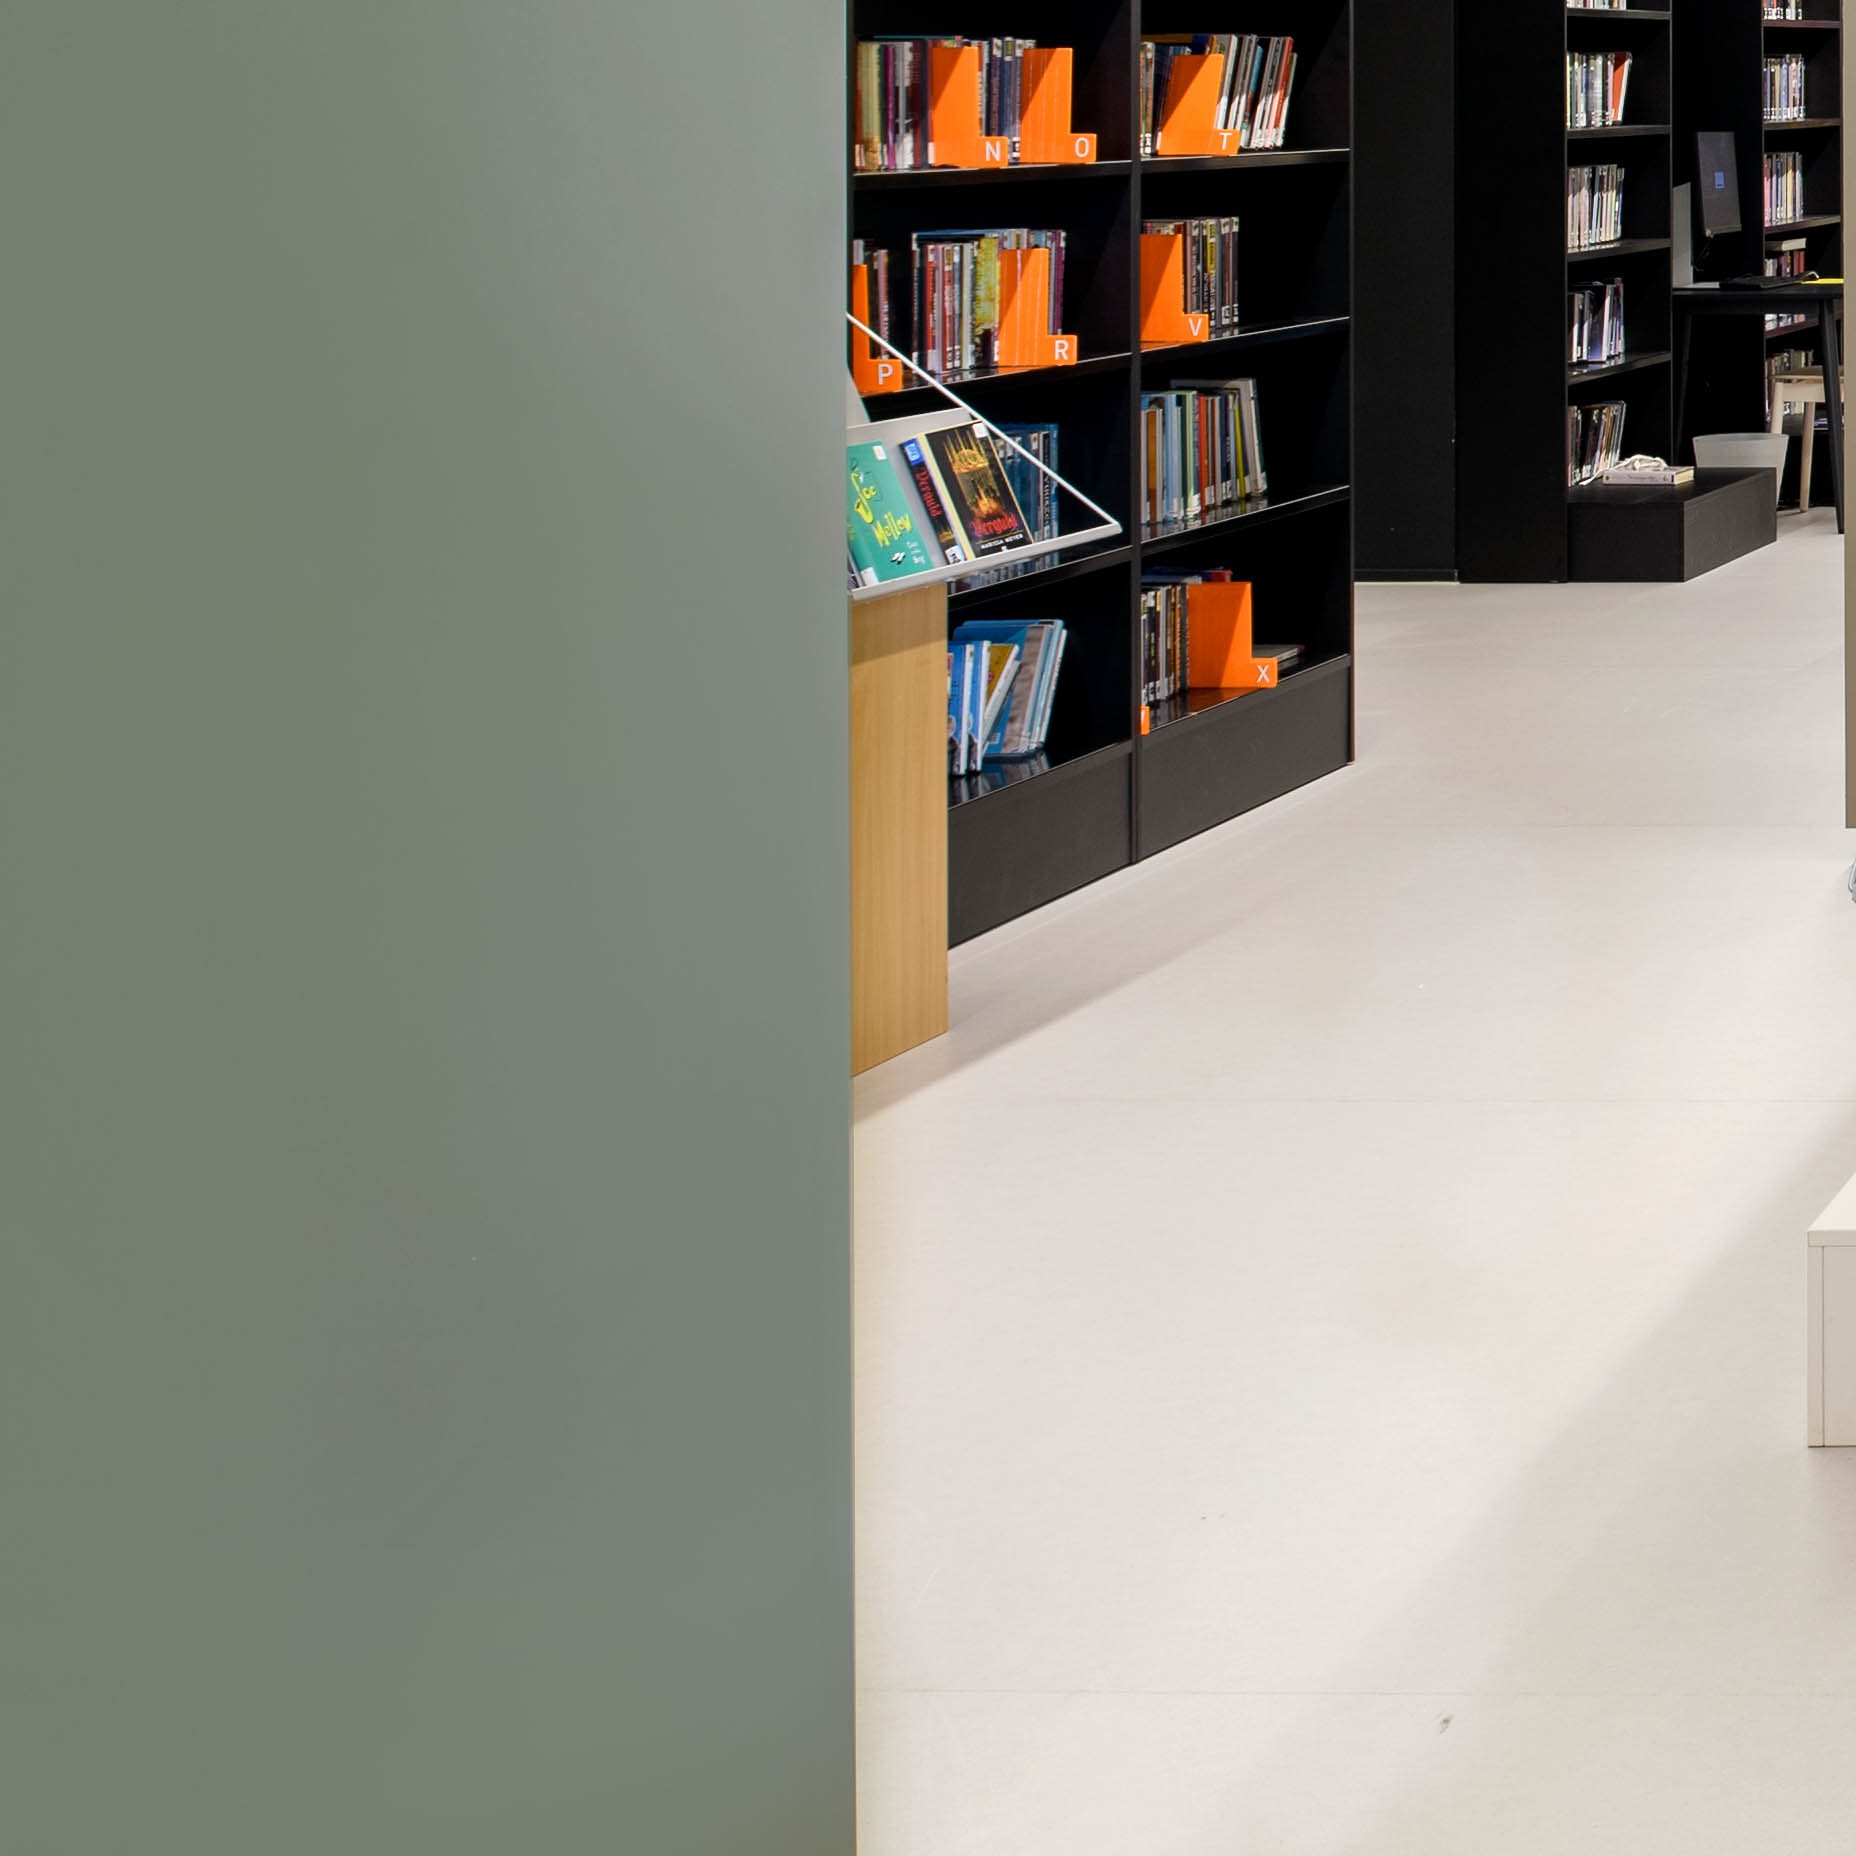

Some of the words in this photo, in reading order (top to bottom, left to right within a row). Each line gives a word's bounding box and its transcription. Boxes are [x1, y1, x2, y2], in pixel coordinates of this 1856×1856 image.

[986, 141, 1001, 161] N
[1074, 137, 1089, 158] O
[1219, 133, 1232, 150] T
[1188, 318, 1201, 337] V
[1054, 340, 1069, 361] R
[877, 363, 894, 385] P
[1256, 664, 1270, 683] X
